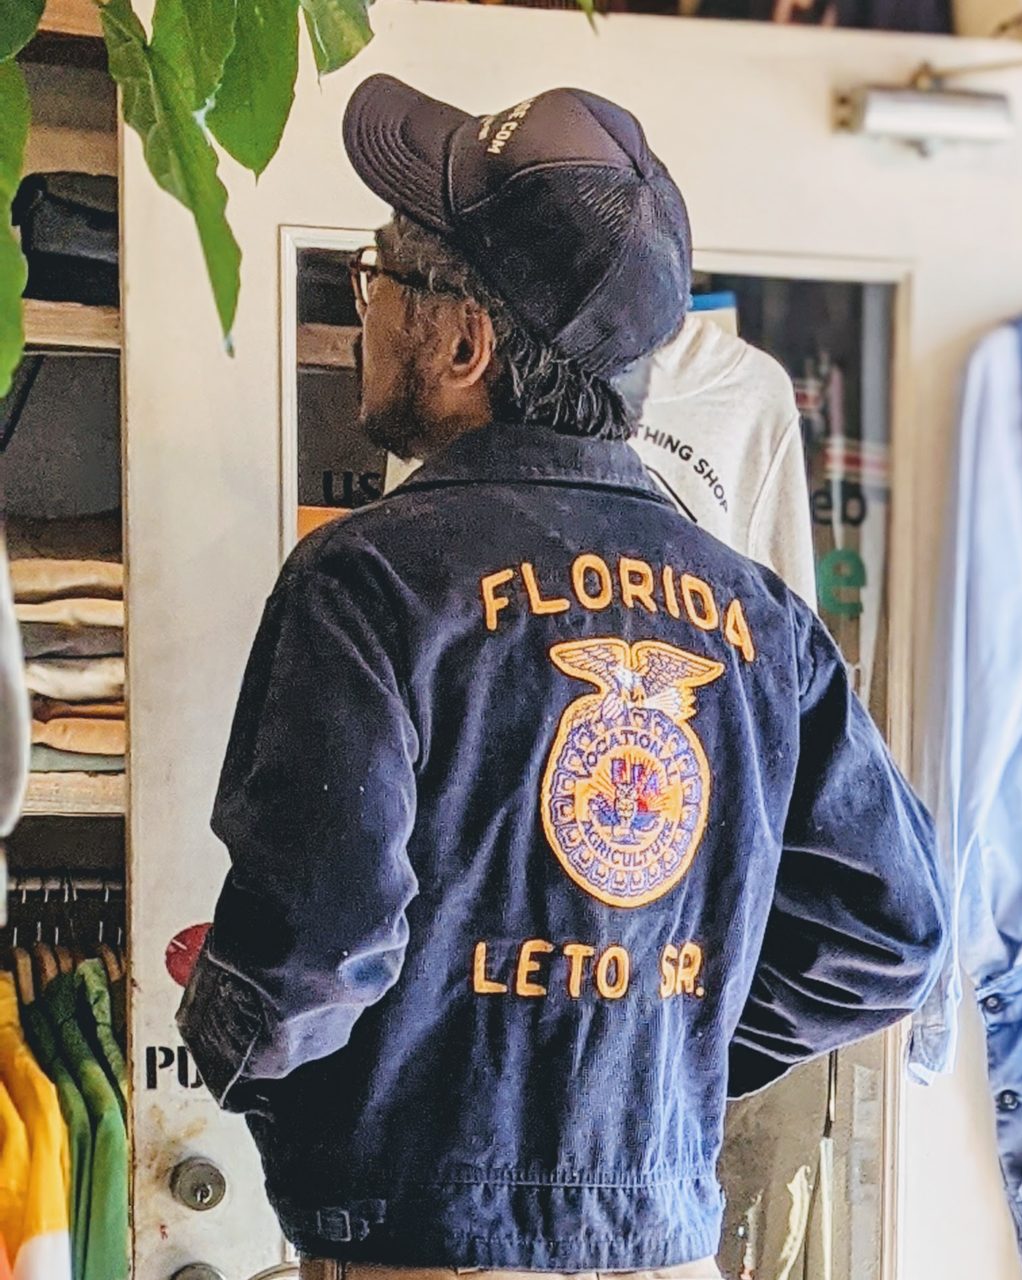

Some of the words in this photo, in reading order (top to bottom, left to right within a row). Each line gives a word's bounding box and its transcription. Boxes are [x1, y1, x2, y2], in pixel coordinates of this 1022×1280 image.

[480, 553, 757, 662] FLORIDA
[581, 820, 675, 867] AGRICULTURE
[472, 938, 632, 999] LETO
[659, 943, 705, 1000] SR.
